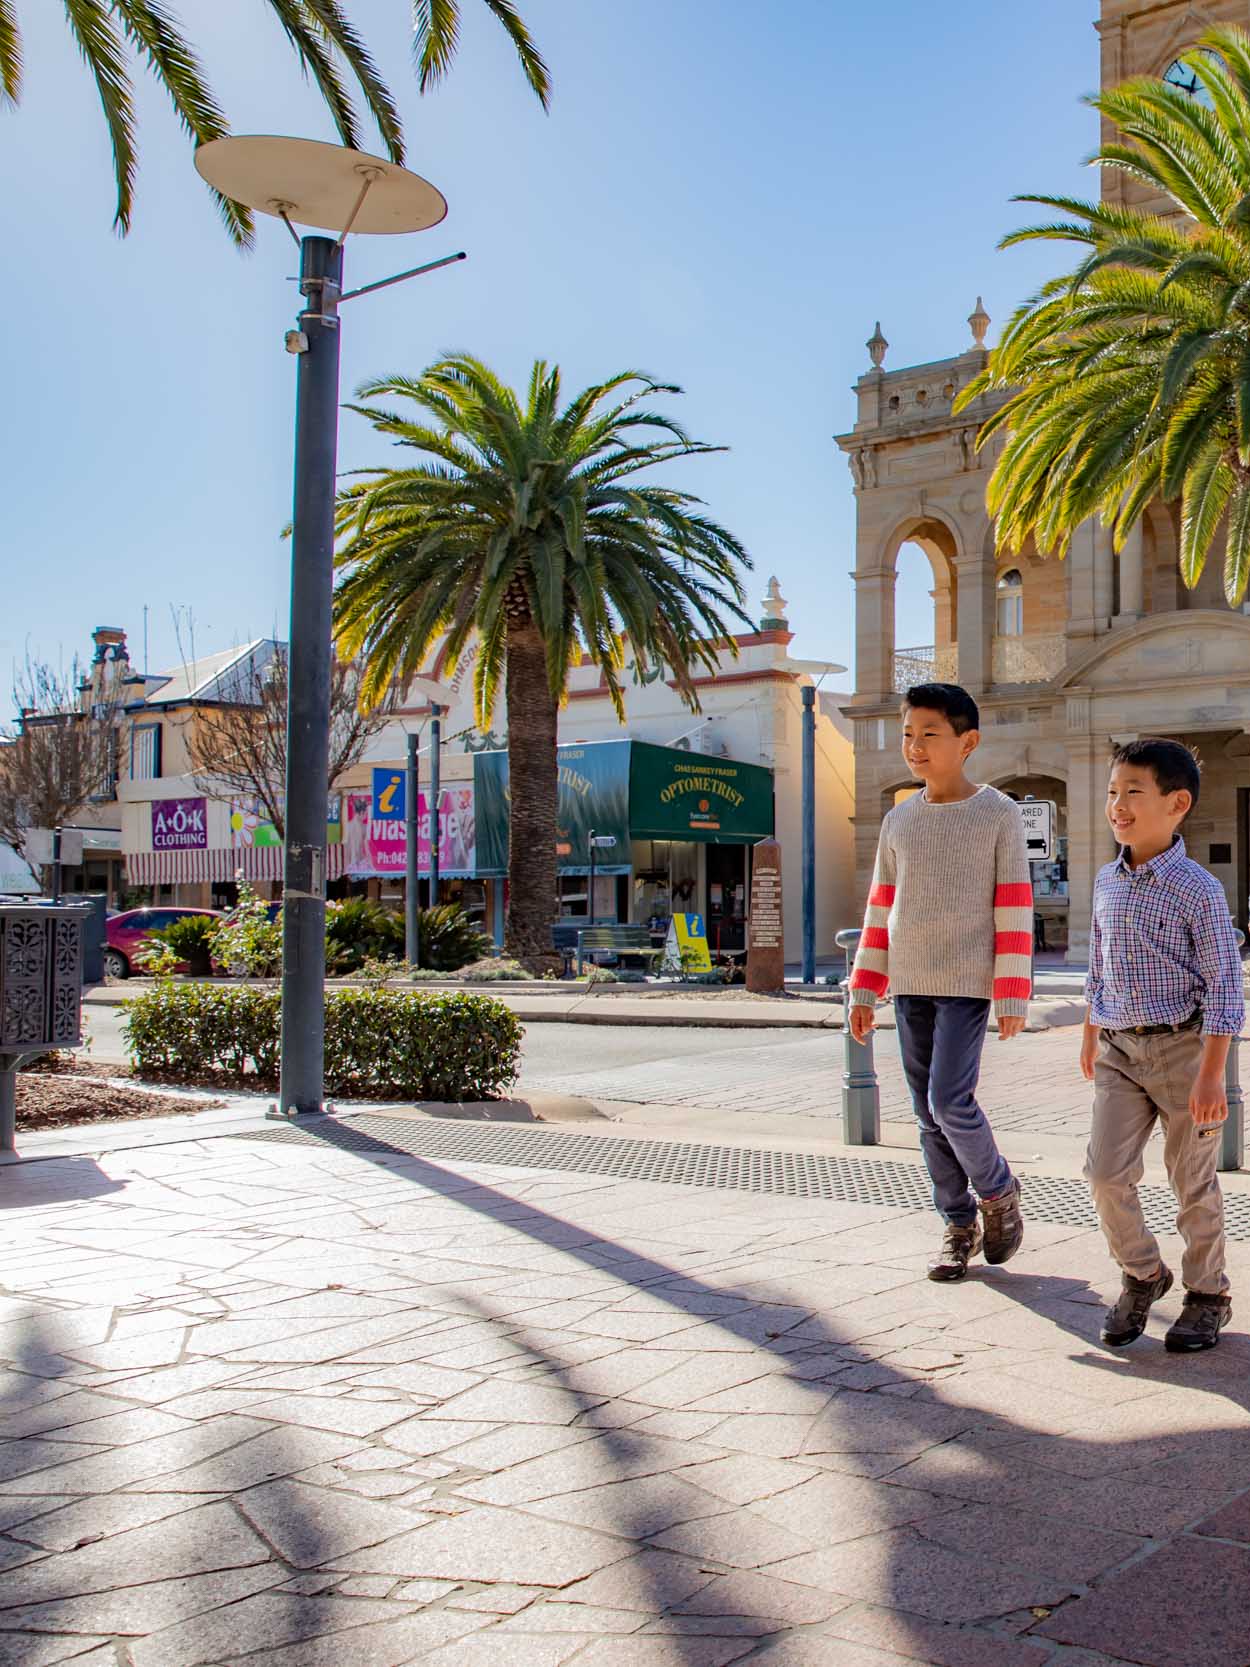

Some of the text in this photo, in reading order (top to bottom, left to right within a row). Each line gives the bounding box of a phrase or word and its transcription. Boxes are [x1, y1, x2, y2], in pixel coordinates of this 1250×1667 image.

[660, 776, 745, 807] OPTOMETRIST
[1021, 807, 1043, 817] ARED
[154, 832, 206, 846] CLOTHING
